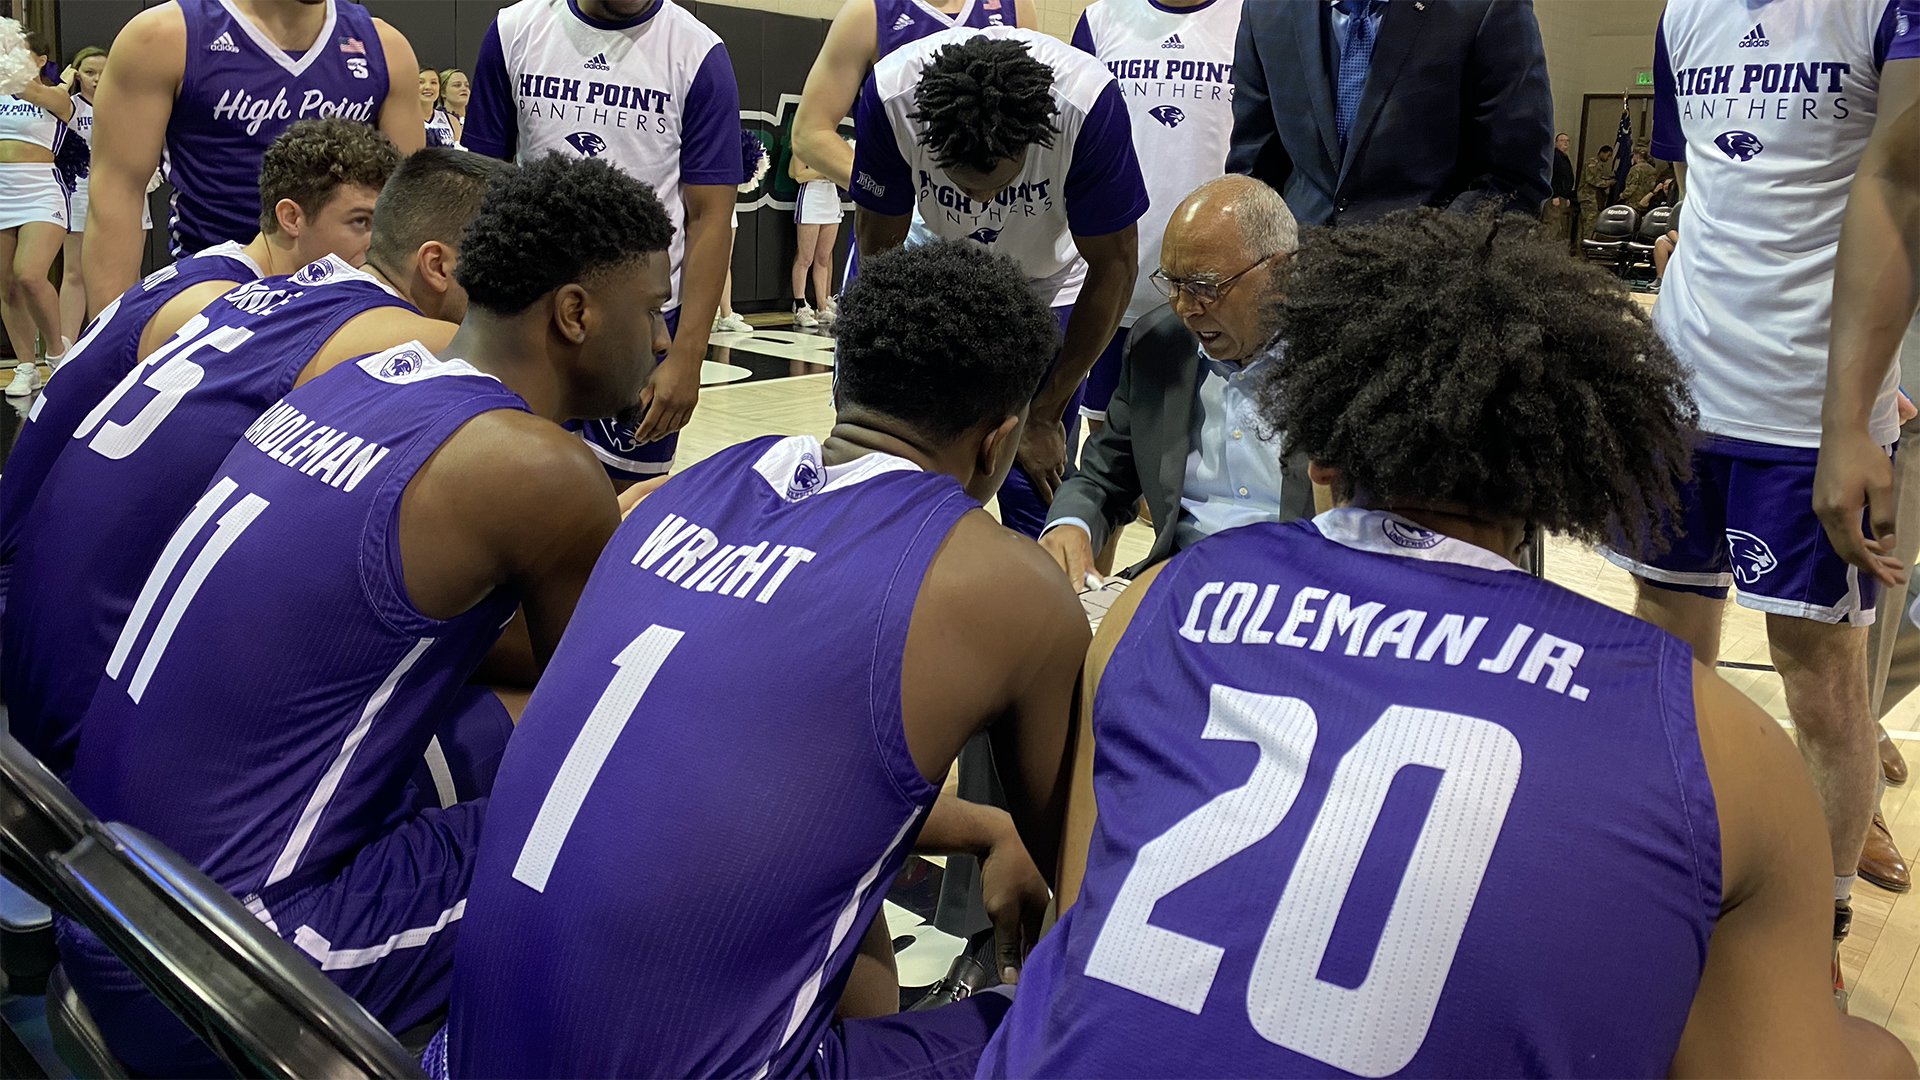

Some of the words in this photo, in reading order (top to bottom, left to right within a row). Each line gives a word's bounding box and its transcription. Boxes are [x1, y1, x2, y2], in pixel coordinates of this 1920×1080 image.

[1738, 38, 1769, 48] adidas
[583, 62, 610, 71] adidas
[1739, 62, 1850, 94] POINT
[213, 86, 291, 136] High
[298, 89, 374, 122] Point
[519, 73, 581, 102] HIGH
[586, 81, 671, 115] POINT
[1119, 82, 1236, 103] ANTHERS
[1683, 98, 1849, 120] ANTHERS
[76, 116, 93, 126] HIG
[519, 99, 667, 135] PANTHERS
[631, 513, 817, 604] WRIGHT
[105, 475, 270, 705] 11
[1178, 581, 1489, 667] COLEMAN
[1477, 624, 1590, 702] JR.
[511, 623, 686, 894] 1
[1083, 683, 1523, 1079] 20
